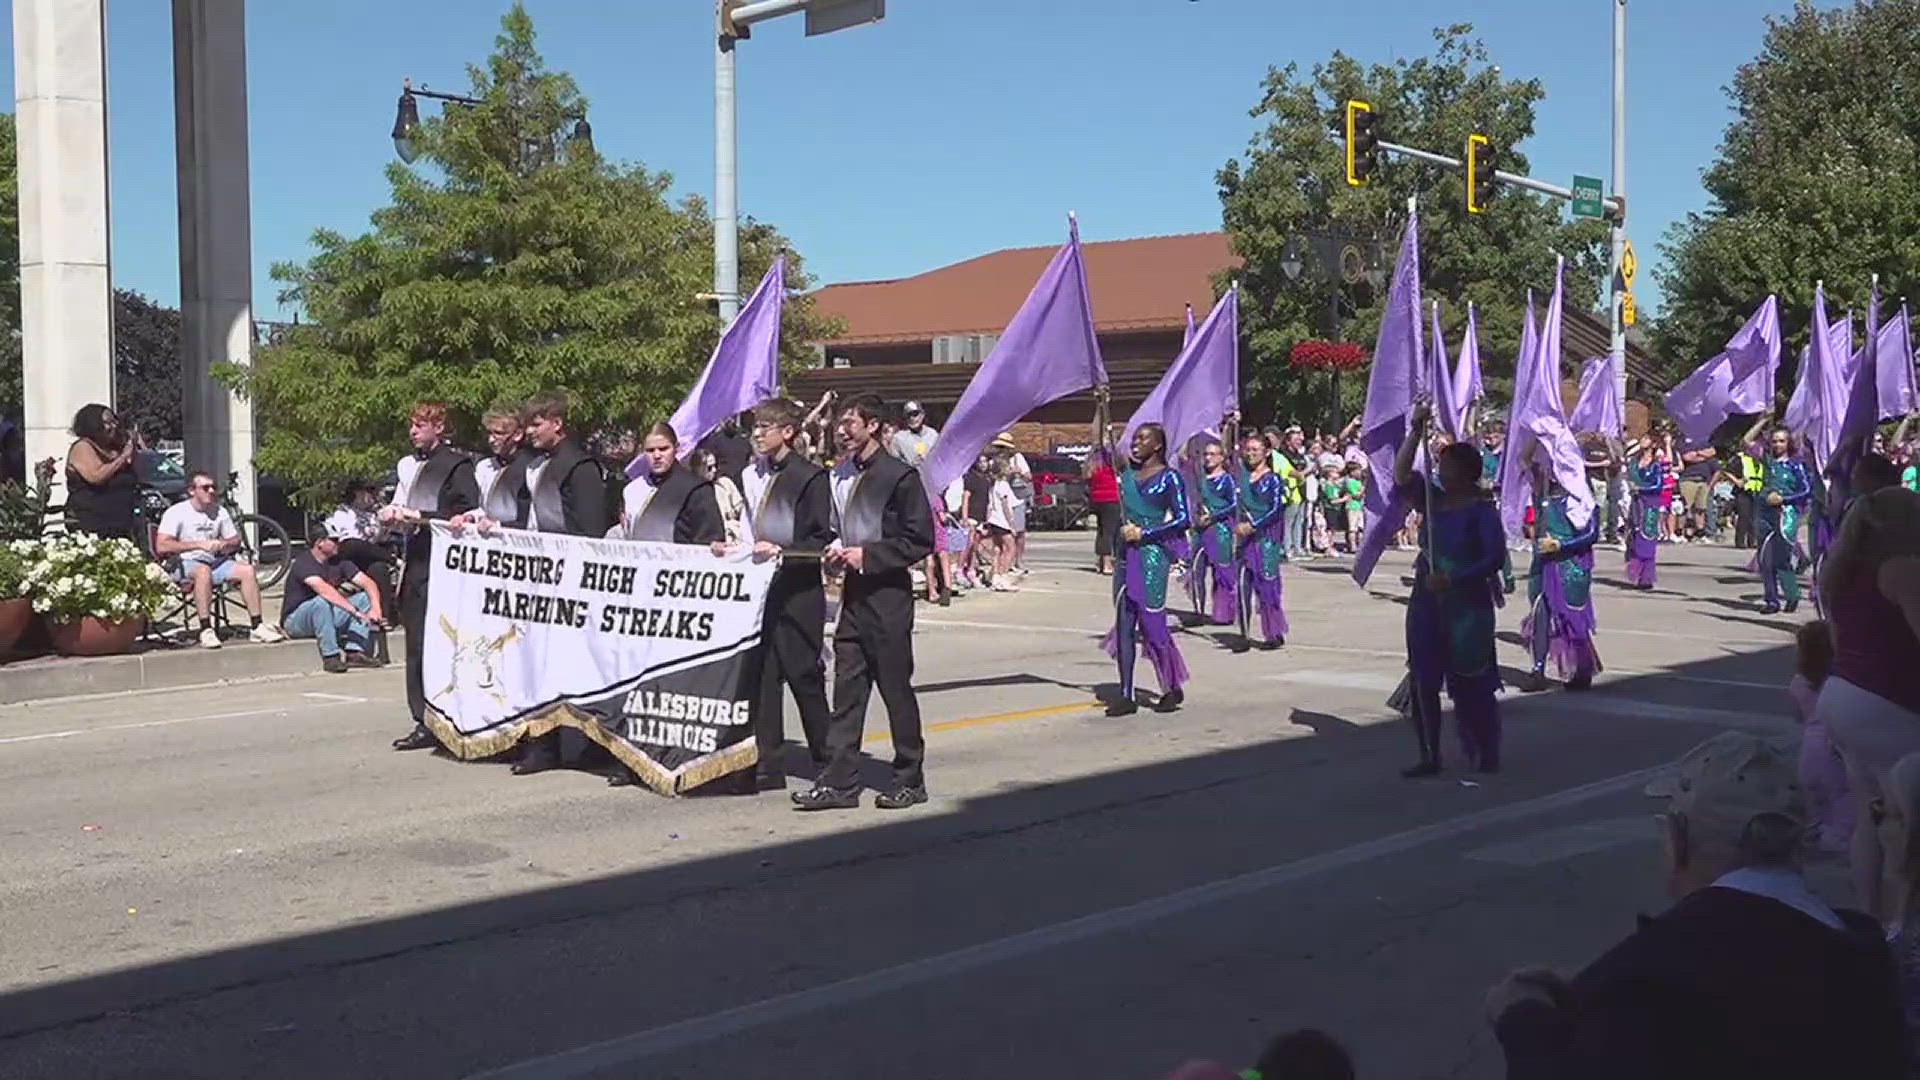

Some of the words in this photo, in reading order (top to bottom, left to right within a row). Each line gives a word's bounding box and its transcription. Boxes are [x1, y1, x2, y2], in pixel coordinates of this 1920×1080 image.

[445, 544, 565, 586] GALESBURG
[580, 561, 637, 595] HIGH
[653, 569, 751, 602] SCHOOL
[600, 604, 714, 641] STREAKS
[627, 718, 717, 753] ILLINOIS
